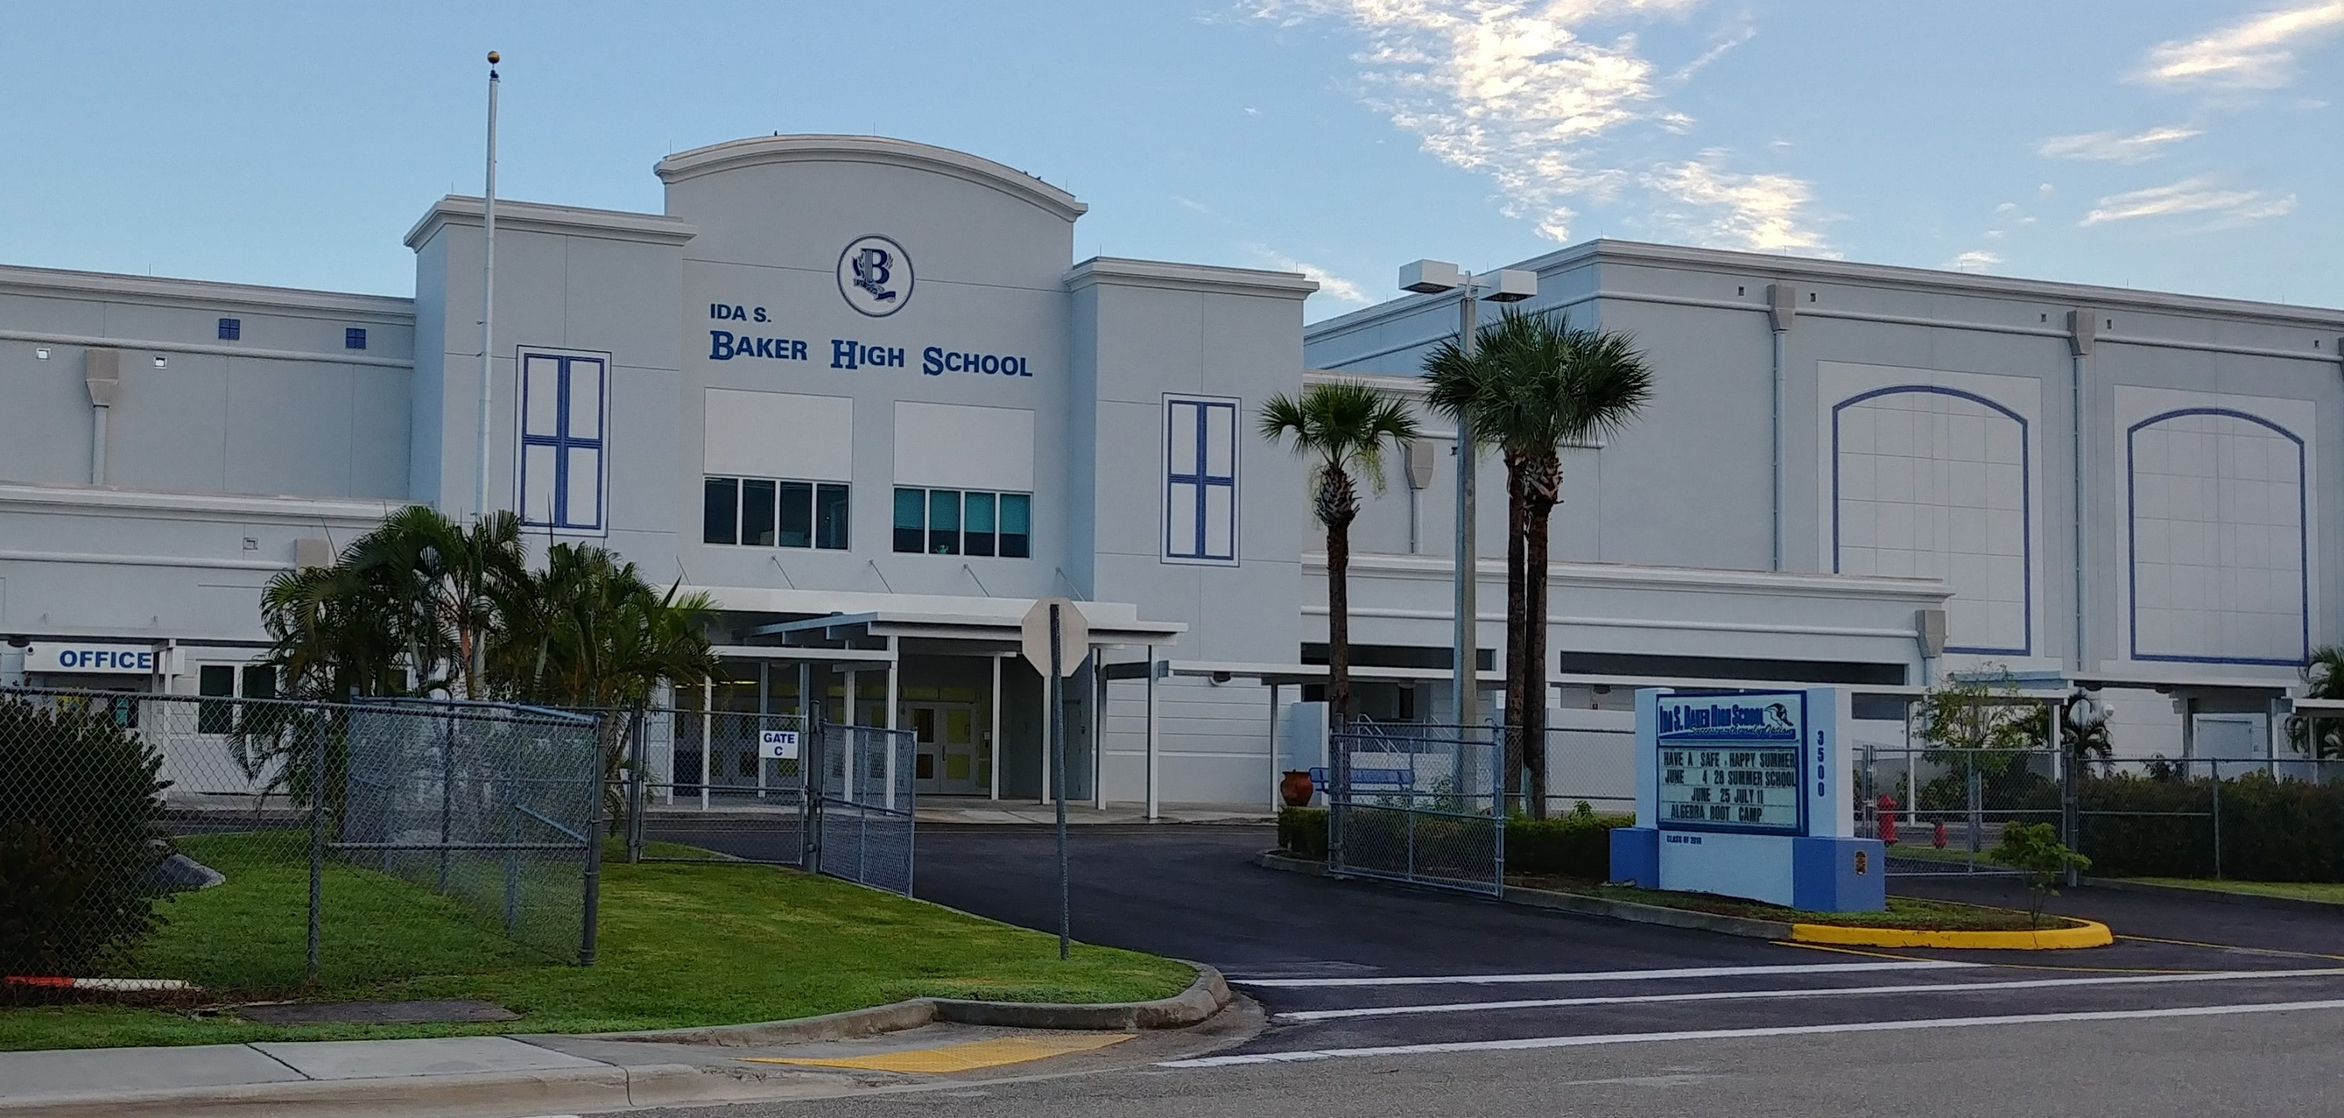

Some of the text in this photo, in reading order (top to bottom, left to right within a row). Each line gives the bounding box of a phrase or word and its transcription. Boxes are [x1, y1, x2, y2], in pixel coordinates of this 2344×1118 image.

[710, 303, 772, 323] IDA S.
[709, 330, 1034, 377] BAKER HIGH SCHOOL
[59, 650, 152, 669] OFFICE
[1732, 703, 1766, 727] SCHOOL
[763, 732, 796, 744] GATE
[774, 746, 784, 757] C
[1663, 751, 1796, 768] HAVE A SAFE HAPPY SUMMER
[1817, 730, 1825, 797] 3500
[1665, 769, 1797, 787] JUNE 4 28 SUMMER SCHOOL
[1691, 787, 1711, 802] JUNE
[1720, 788, 1731, 804] 25
[1734, 788, 1754, 804] JULY
[1671, 804, 1763, 823] ALGEBRA BOOT CAMP
